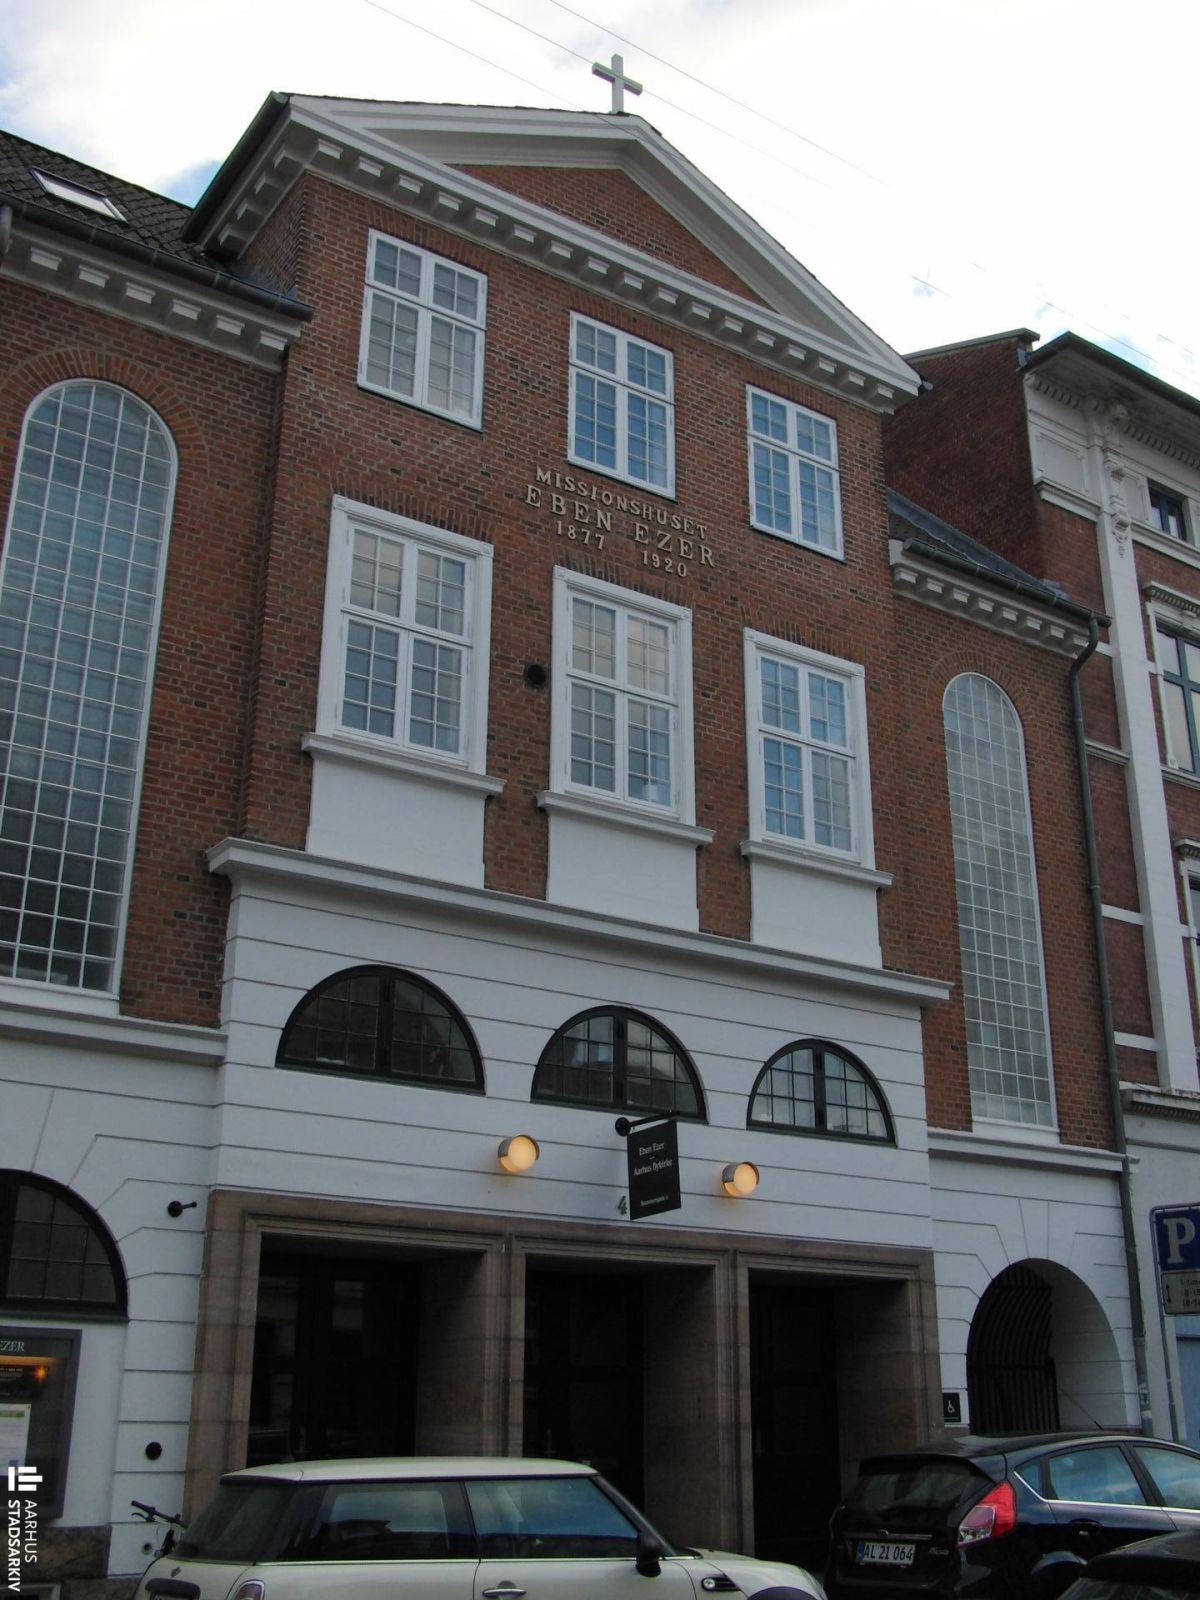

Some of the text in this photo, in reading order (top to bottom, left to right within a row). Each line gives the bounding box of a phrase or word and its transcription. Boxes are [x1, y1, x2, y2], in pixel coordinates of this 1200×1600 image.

[525, 484, 715, 568] EBEN EZER
[536, 466, 707, 540] MISSIONSHUSET
[556, 520, 687, 577] 1877 1920
[618, 1195, 627, 1215] 4
[1163, 1217, 1195, 1263] P
[864, 1544, 876, 1559] AL
[878, 1545, 890, 1559] 21
[893, 1546, 913, 1561] 064
